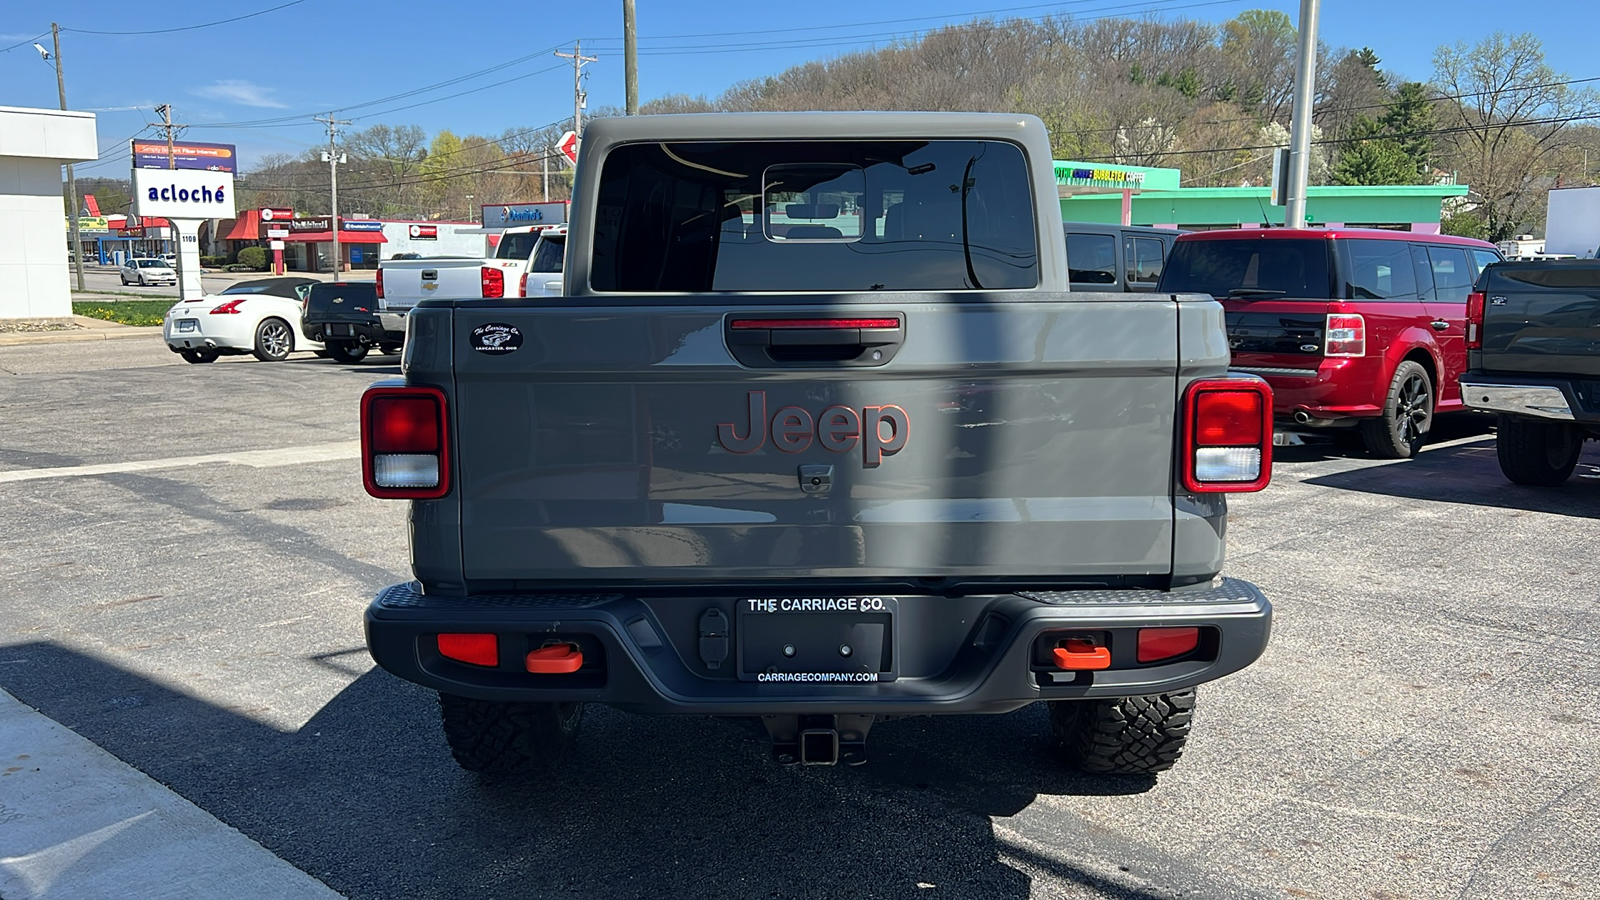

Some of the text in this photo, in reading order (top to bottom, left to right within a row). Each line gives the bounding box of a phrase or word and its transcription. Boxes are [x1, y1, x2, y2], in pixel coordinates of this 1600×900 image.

[148, 184, 224, 203] acloché
[509, 208, 543, 221] Domino's
[717, 390, 911, 469] Jeep
[748, 597, 886, 612] THE CARRIAGE CO.
[757, 672, 878, 682] CARRIAGECOMPANY.COM
